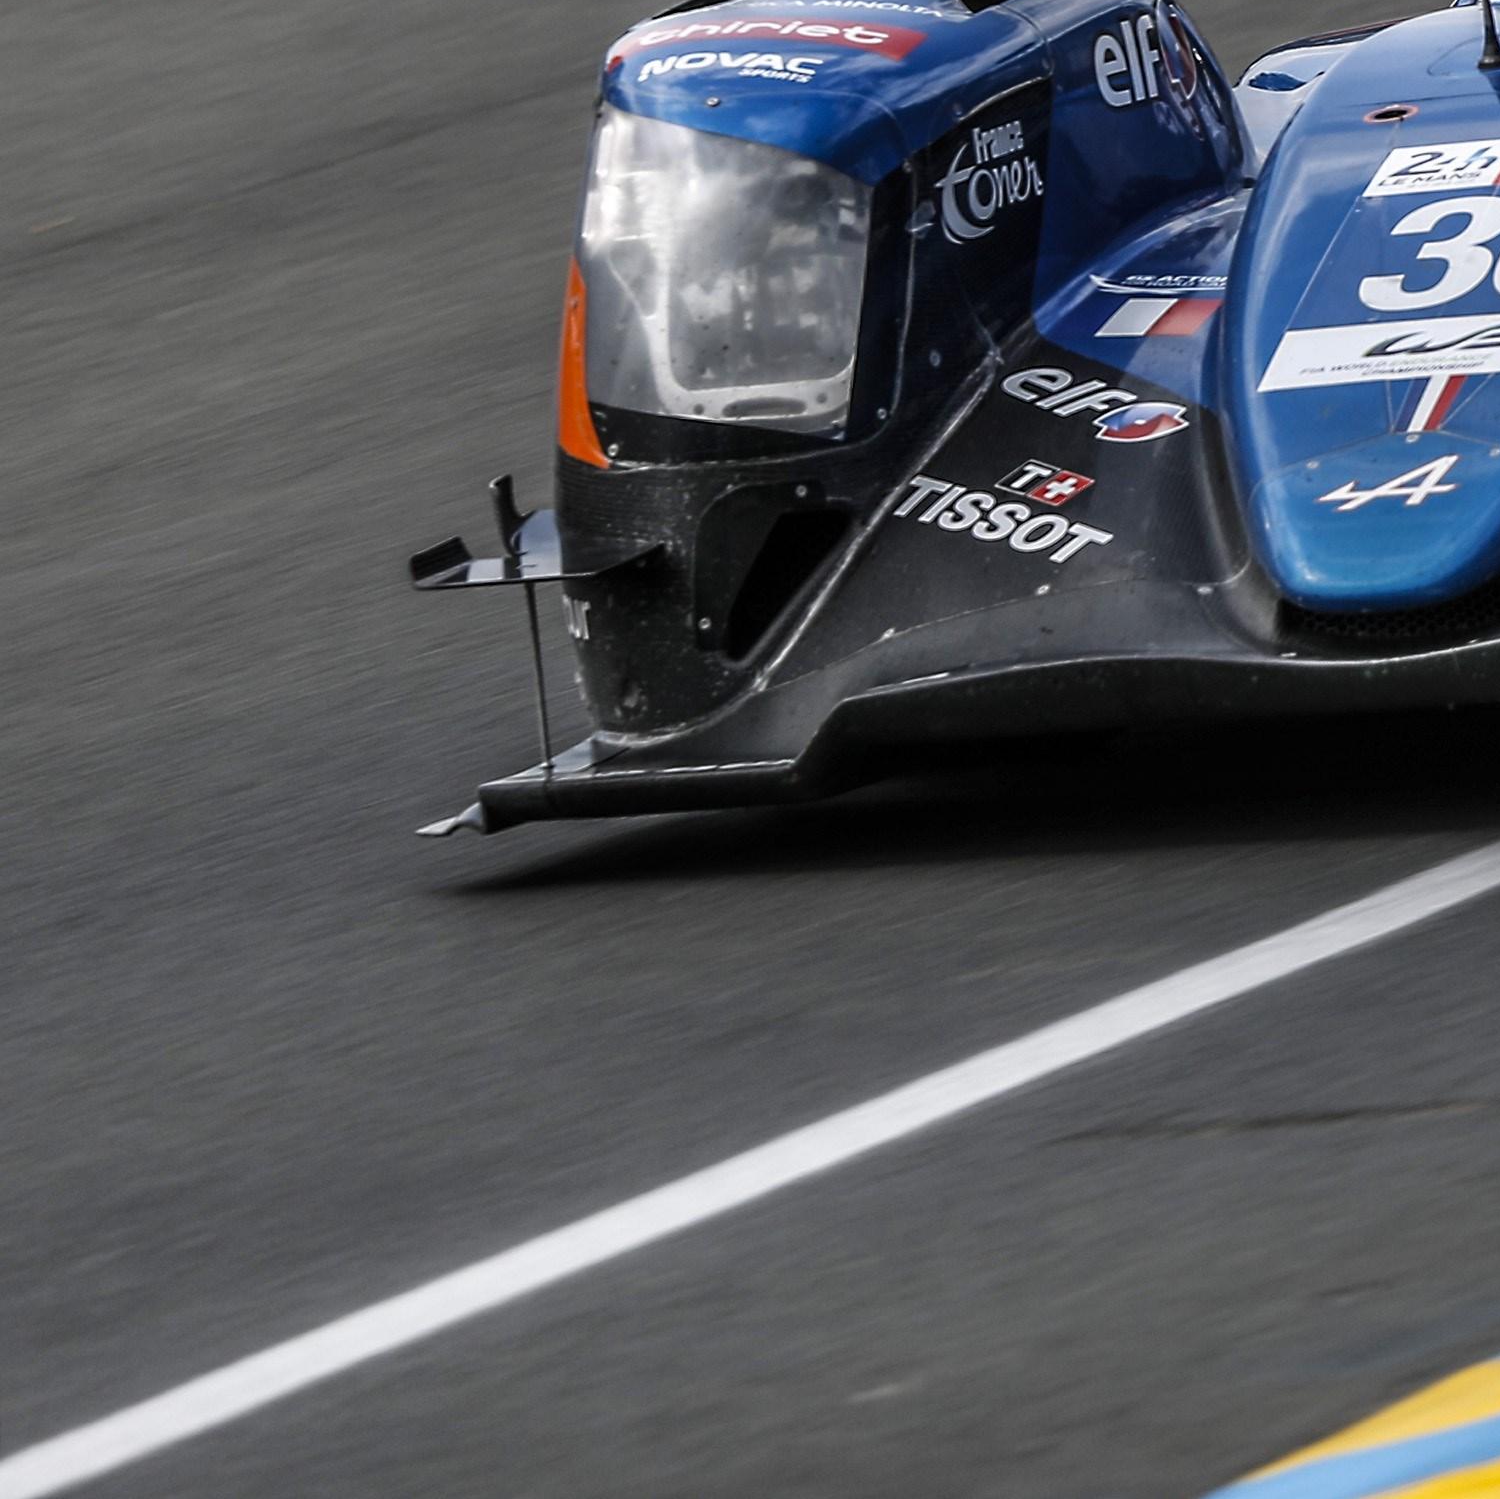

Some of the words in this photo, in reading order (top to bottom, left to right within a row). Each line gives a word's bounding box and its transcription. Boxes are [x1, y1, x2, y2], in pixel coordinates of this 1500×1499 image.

[637, 51, 824, 83] NOVAC
[738, 66, 813, 84] SPORTS
[1094, 13, 1161, 108] elf
[972, 120, 1025, 165] France
[1001, 366, 1137, 419] elf
[892, 473, 1115, 565] TISSOT
